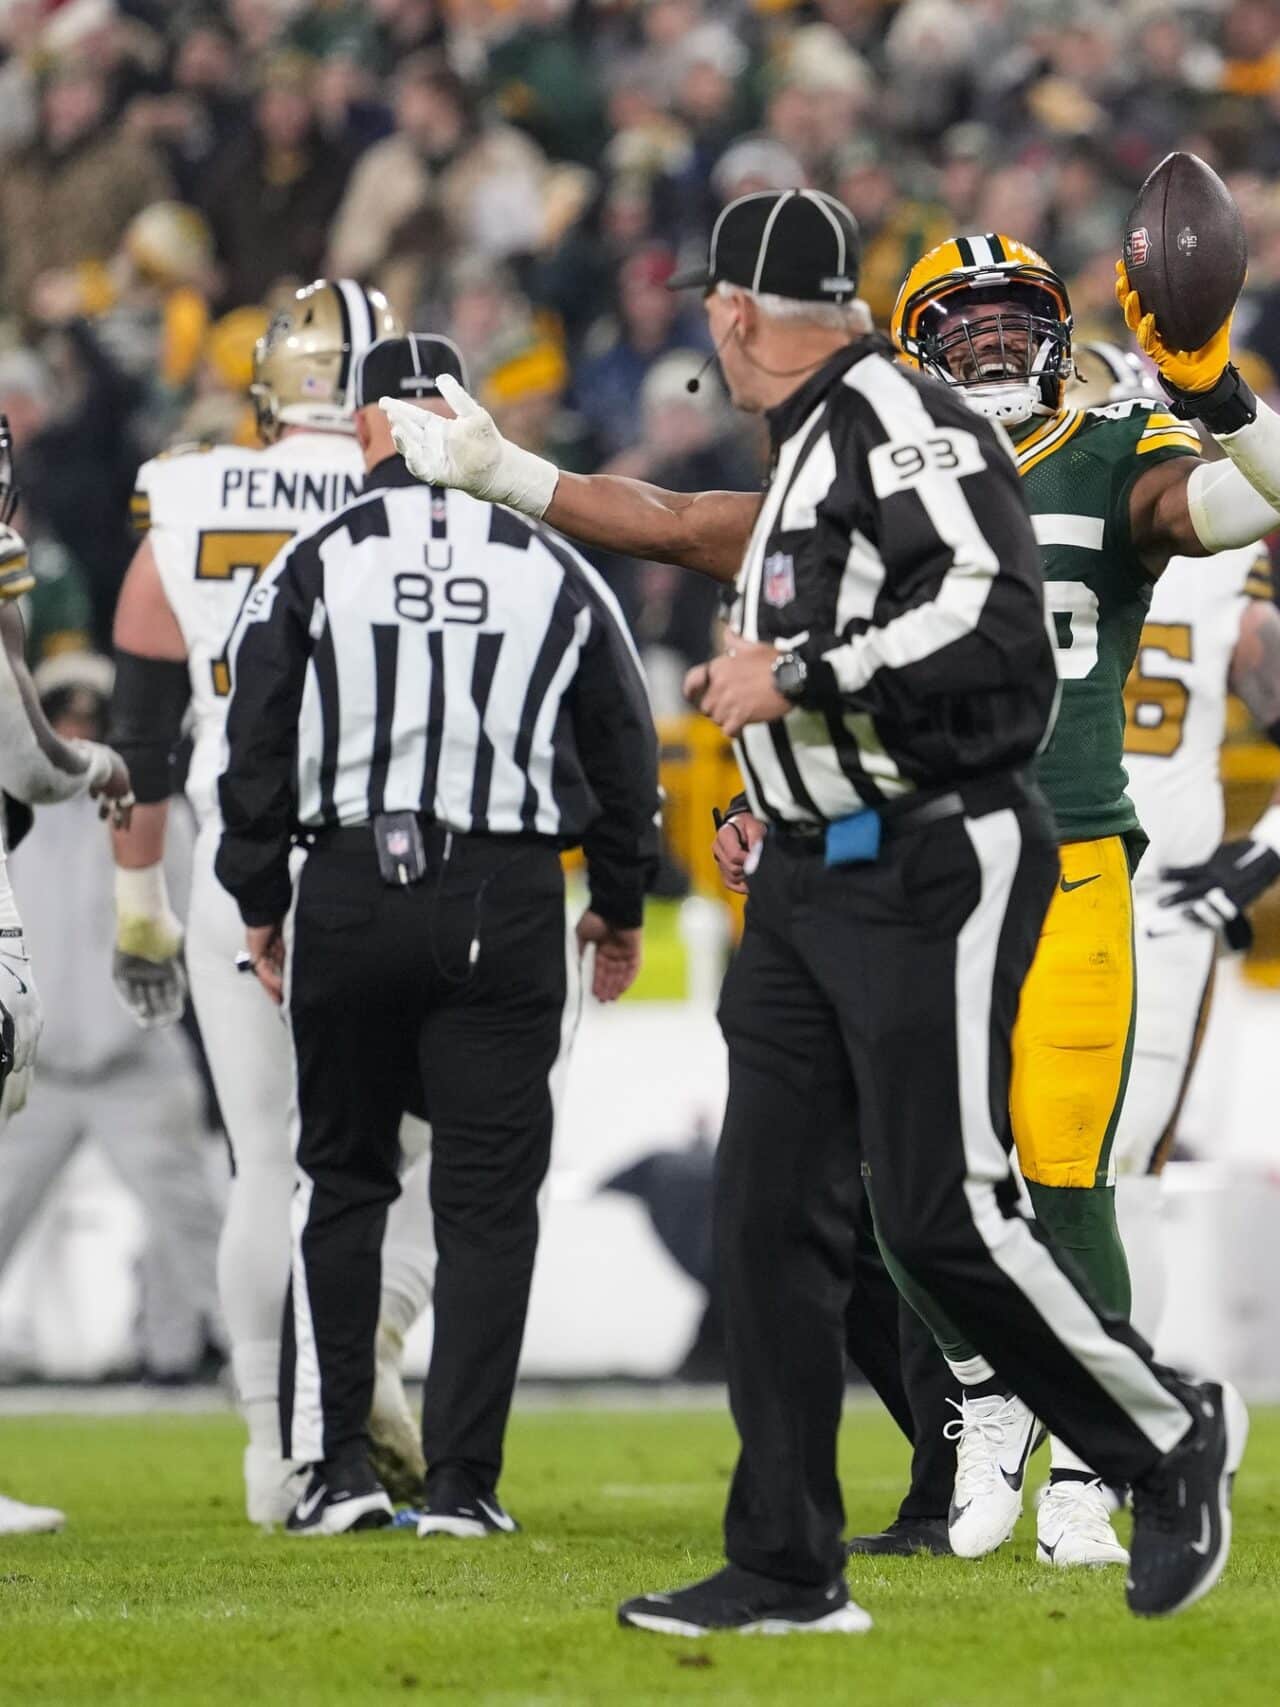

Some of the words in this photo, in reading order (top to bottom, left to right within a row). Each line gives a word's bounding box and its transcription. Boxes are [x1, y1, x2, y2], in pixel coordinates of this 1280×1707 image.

[1132, 231, 1145, 264] NFL
[890, 439, 960, 480] 93
[423, 543, 453, 571] U
[393, 573, 489, 624] 89
